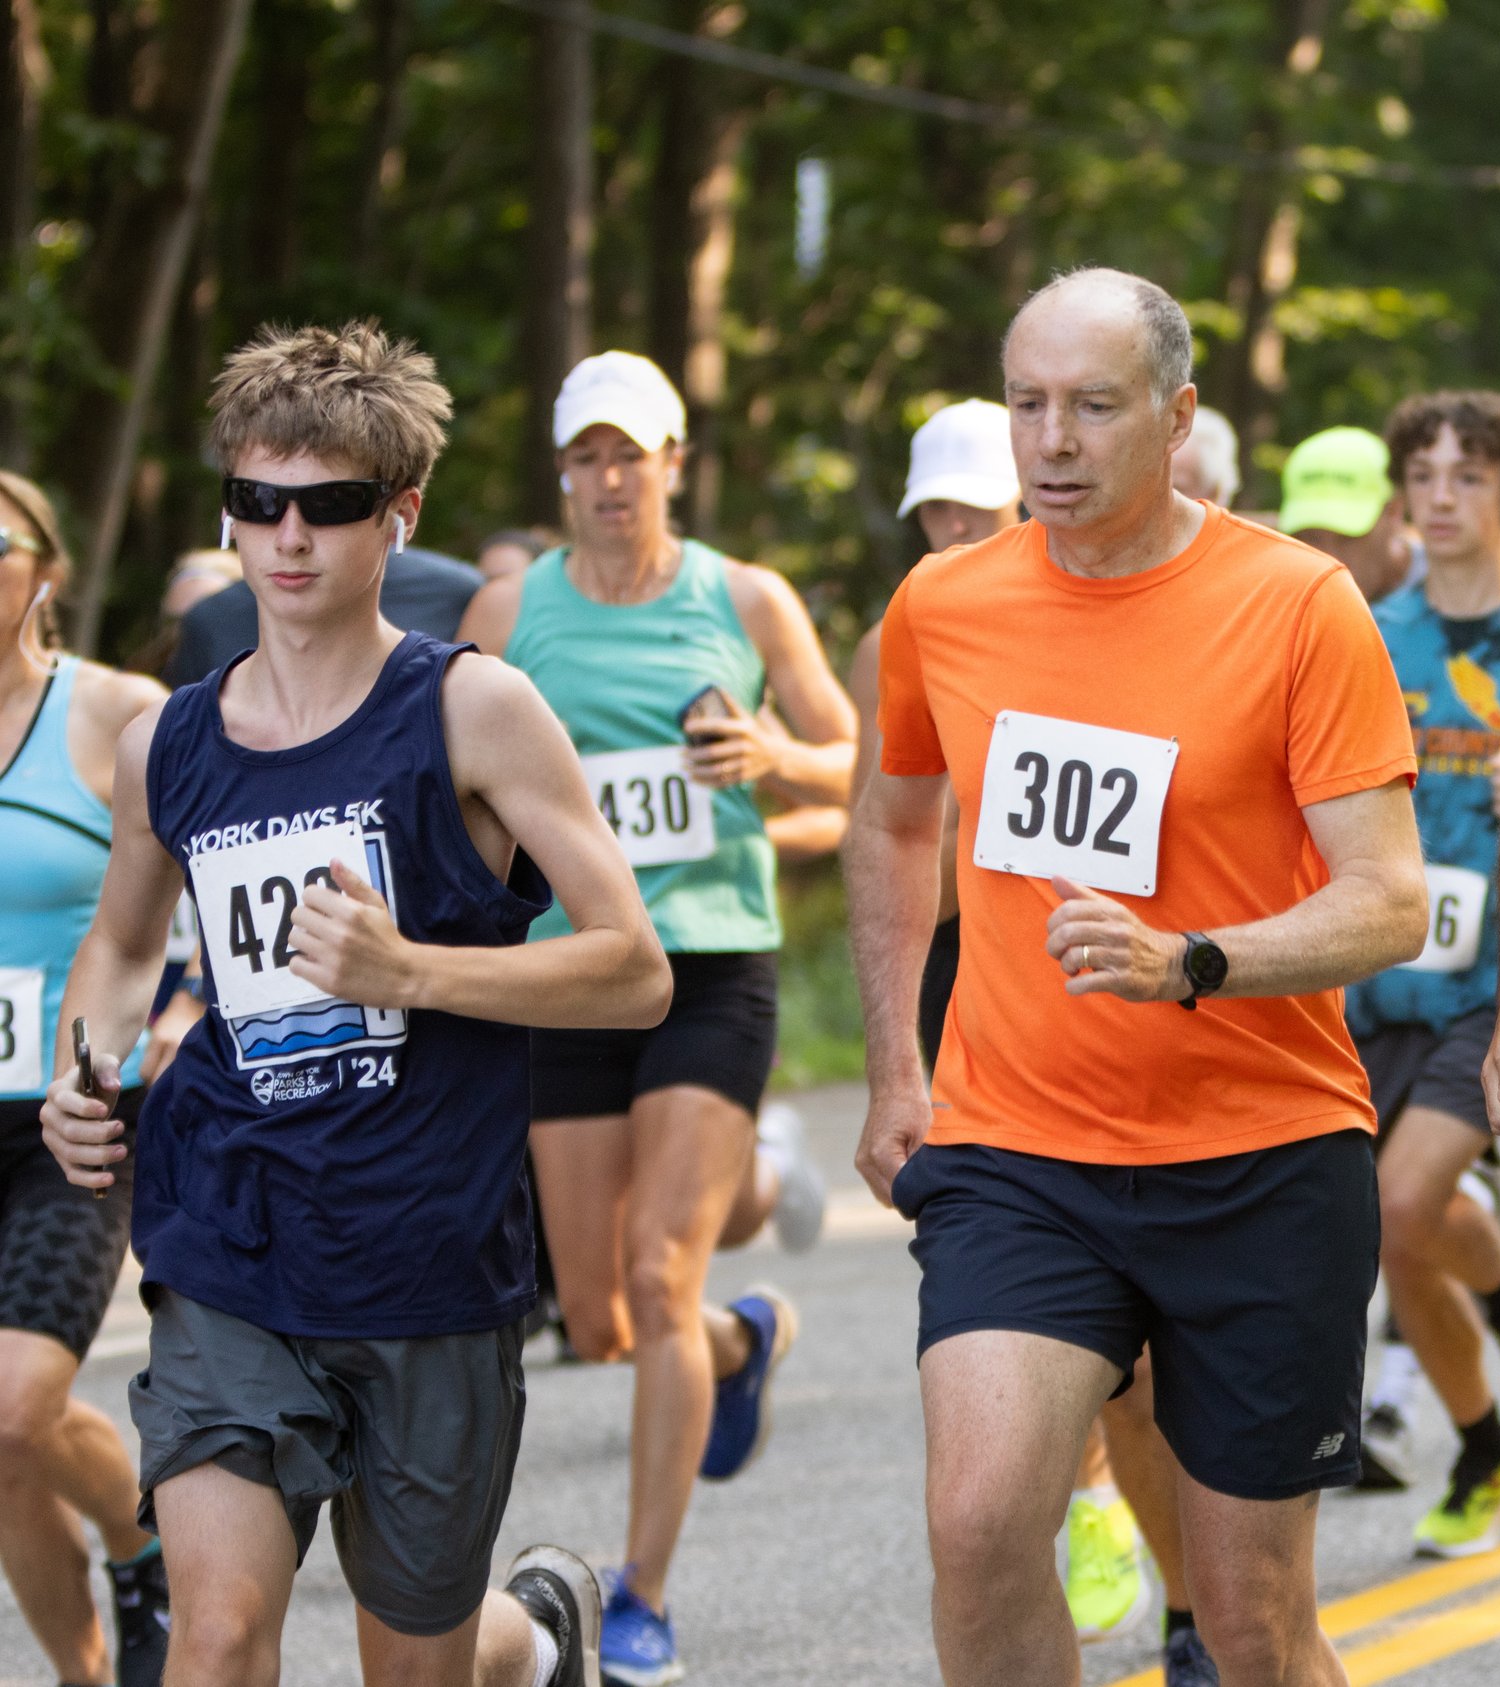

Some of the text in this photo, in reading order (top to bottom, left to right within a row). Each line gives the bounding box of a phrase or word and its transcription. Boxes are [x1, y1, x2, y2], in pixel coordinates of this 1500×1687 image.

[600, 776, 690, 838] 430
[1007, 751, 1138, 857] 302
[189, 799, 386, 854] YORK DAYS 5K
[274, 1074, 315, 1090] PARKS &
[306, 1066, 320, 1074] YORK
[351, 1055, 397, 1089] '24
[274, 1081, 333, 1102] RECREATION
